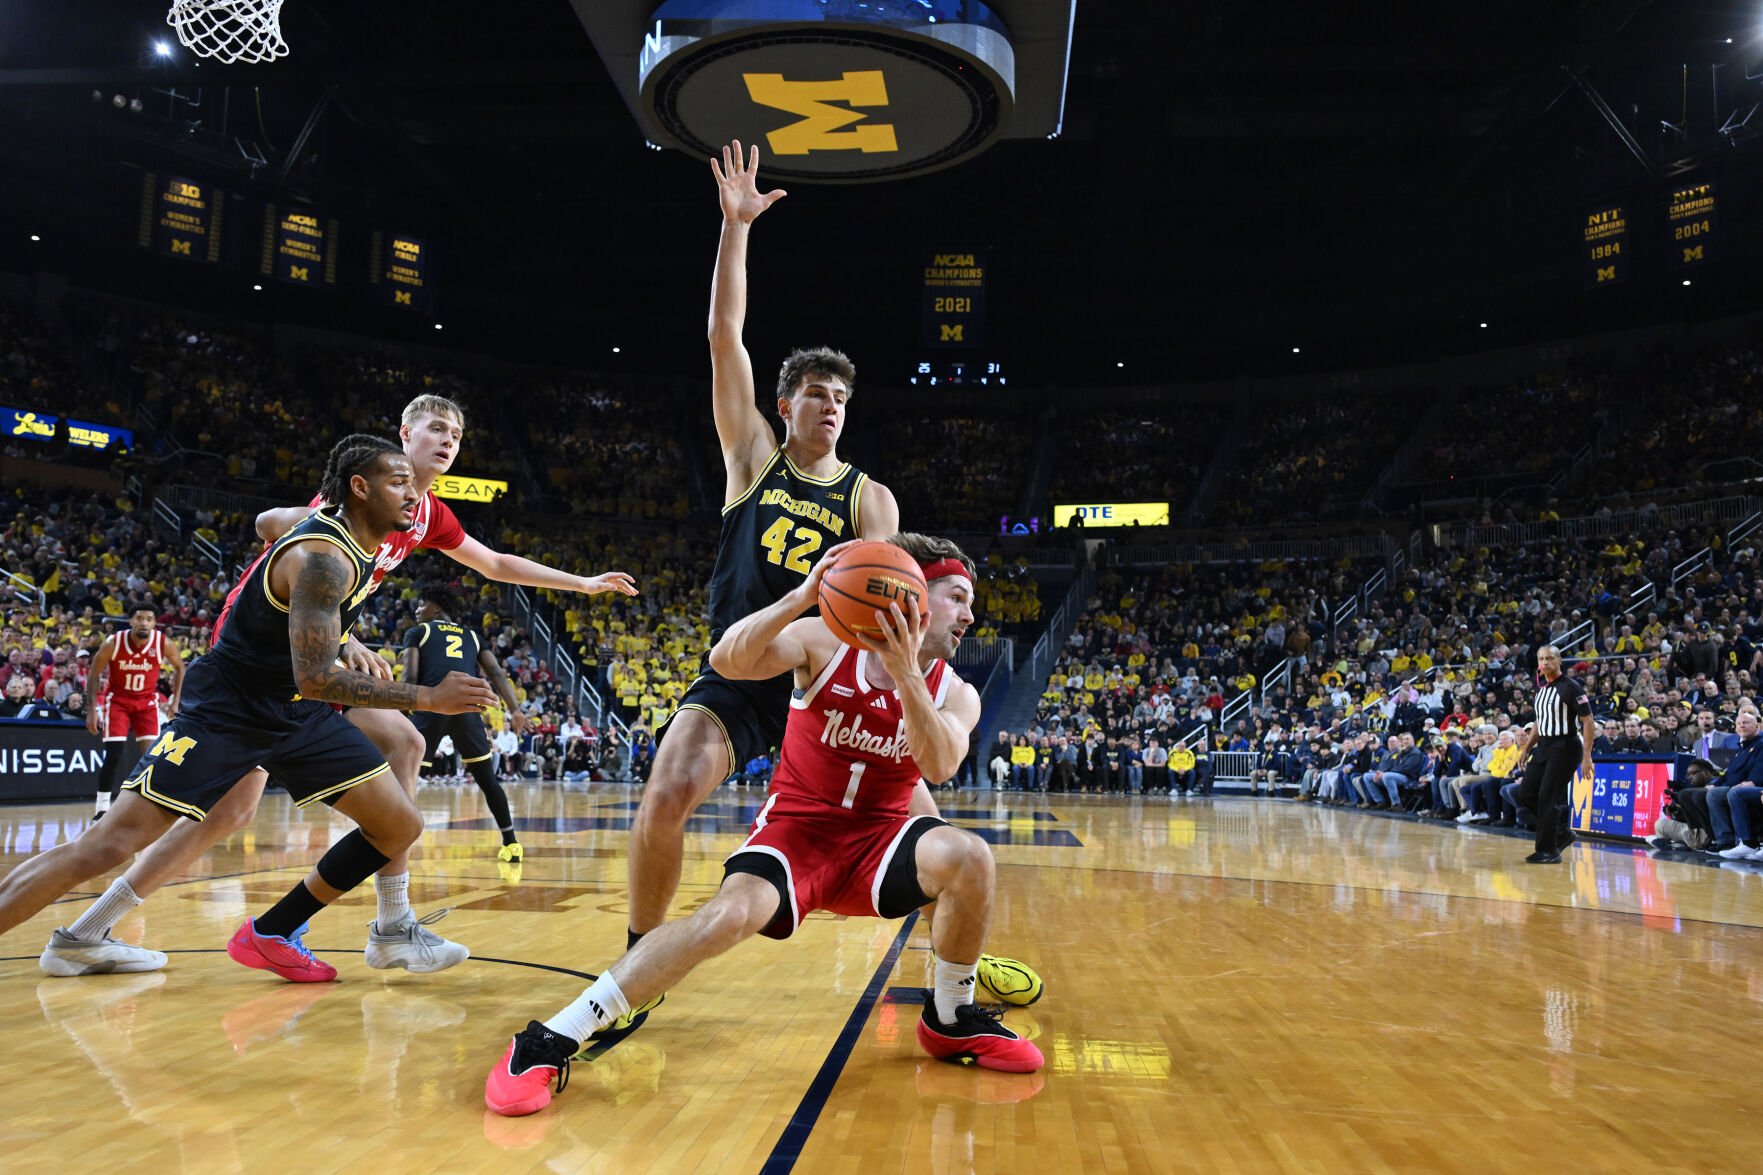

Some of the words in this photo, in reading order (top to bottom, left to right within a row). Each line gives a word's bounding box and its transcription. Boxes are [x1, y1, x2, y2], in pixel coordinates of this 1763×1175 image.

[742, 70, 899, 155] M
[1669, 196, 1714, 214] CHAMPIONS
[287, 213, 318, 228] NCAA
[1588, 207, 1622, 226] NIT
[1584, 219, 1625, 236] CHAMPIONS
[1675, 219, 1710, 240] 2004
[170, 238, 192, 256] M
[392, 239, 420, 254] NCAA
[1591, 242, 1621, 261] 1984
[1682, 244, 1704, 263] M
[934, 254, 975, 267] NCAA
[289, 264, 309, 281] M
[924, 267, 983, 279] CHAMPIONS
[1596, 265, 1616, 282] M
[394, 290, 412, 305] M
[935, 297, 971, 313] 2021
[940, 324, 964, 341] M
[987, 362, 1001, 375] 31
[431, 479, 501, 497] SSAN
[759, 488, 845, 537] MICHIGAN
[761, 516, 822, 575] 42
[445, 634, 463, 659] 2
[118, 658, 153, 672] Nebraska
[124, 673, 145, 691] 10
[150, 731, 198, 766] M
[841, 760, 866, 809] 1
[1593, 778, 1606, 797] 25
[1636, 779, 1649, 799] 31
[1611, 792, 1628, 807] 8:26
